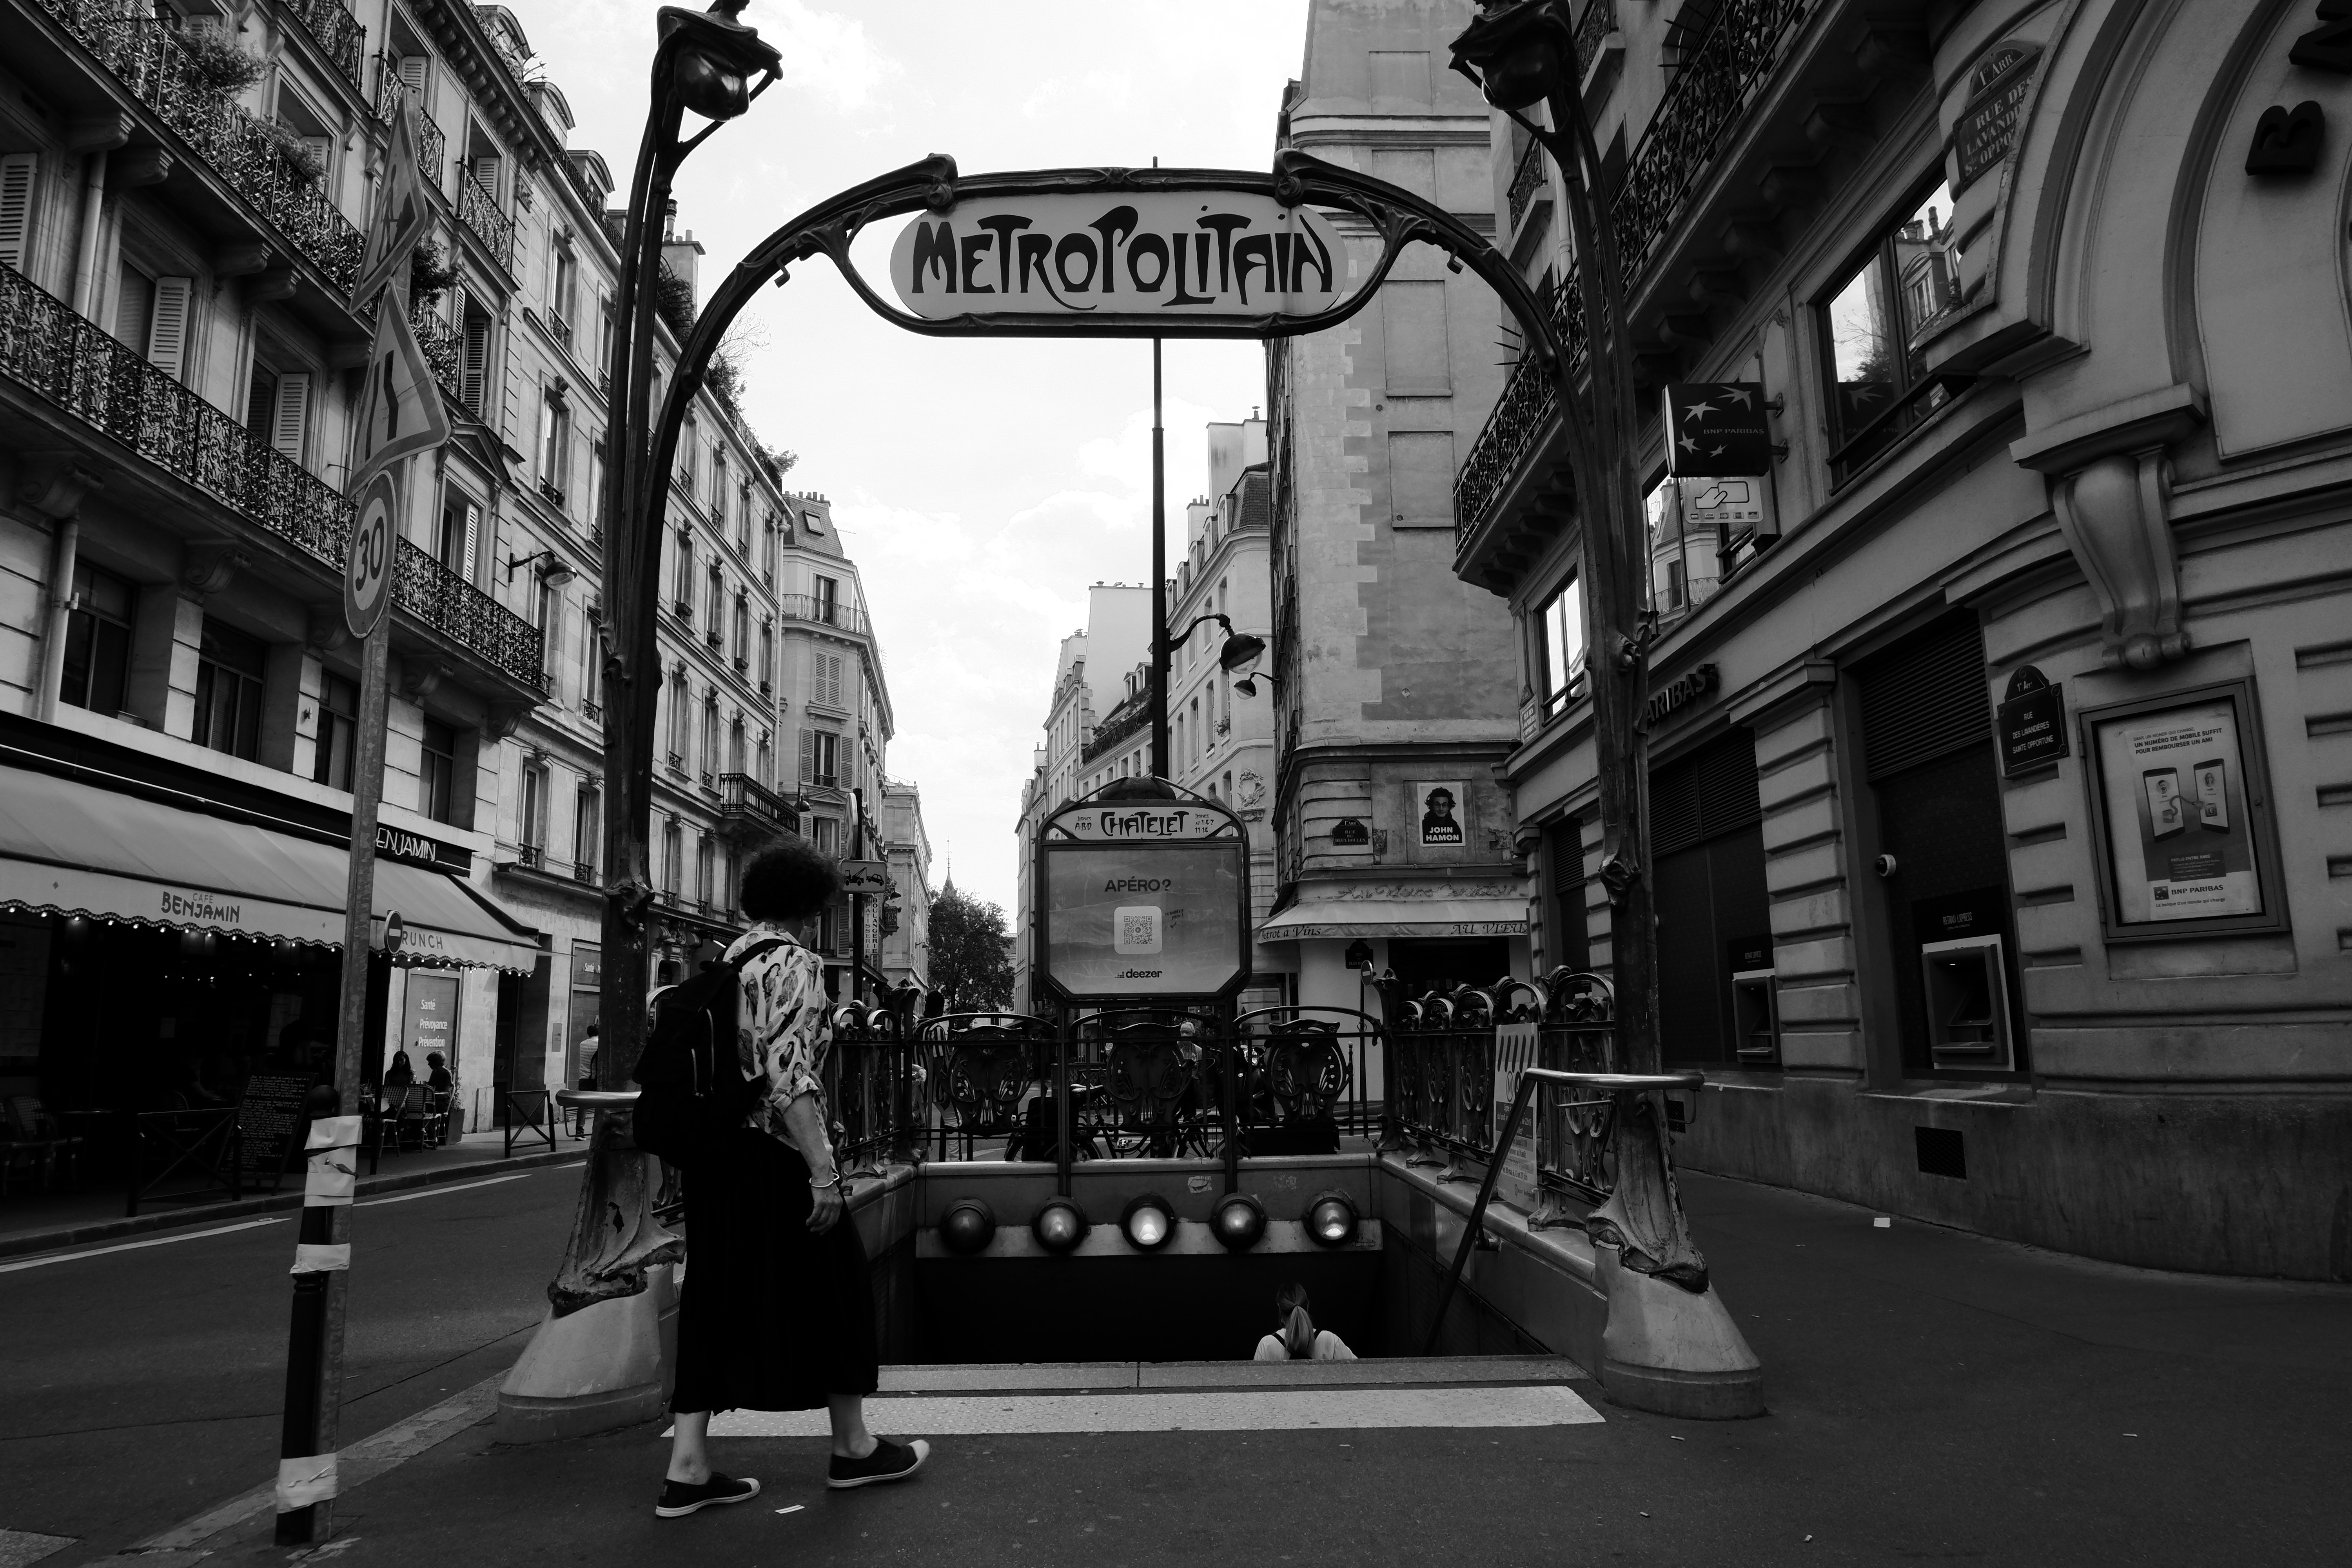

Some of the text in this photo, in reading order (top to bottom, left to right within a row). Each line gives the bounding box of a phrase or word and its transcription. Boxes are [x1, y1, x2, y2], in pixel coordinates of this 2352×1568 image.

[1976, 100, 2004, 130] RUE
[911, 205, 1332, 310] METROPOLITAIN
[355, 516, 385, 591] 30
[1647, 664, 1715, 724] ARIBAS
[2024, 711, 2033, 720] RUE
[2012, 721, 2050, 739] DES LAVANDIÈRES
[2012, 735, 2054, 754] SAINTE OPPORTUNE
[2144, 737, 2169, 746] NUMÉRO
[2180, 732, 2201, 740] MOBILE
[2152, 741, 2190, 751] REMBOURSER
[1101, 811, 1189, 837] CHÂTELET
[376, 827, 436, 862] ENJAMIN
[2190, 885, 2223, 893] PARIBAS
[193, 893, 213, 904] CAFÉ
[161, 891, 240, 923] BENJAMIN
[1283, 927, 1289, 937] à
[1293, 925, 1321, 936] Vins
[1451, 924, 1475, 934] AU
[402, 931, 443, 949] RUNCH
[1126, 968, 1163, 978] deezer
[421, 998, 436, 1010] Santé
[419, 1017, 448, 1032] Prévoyance
[418, 1035, 445, 1047] Prévention
